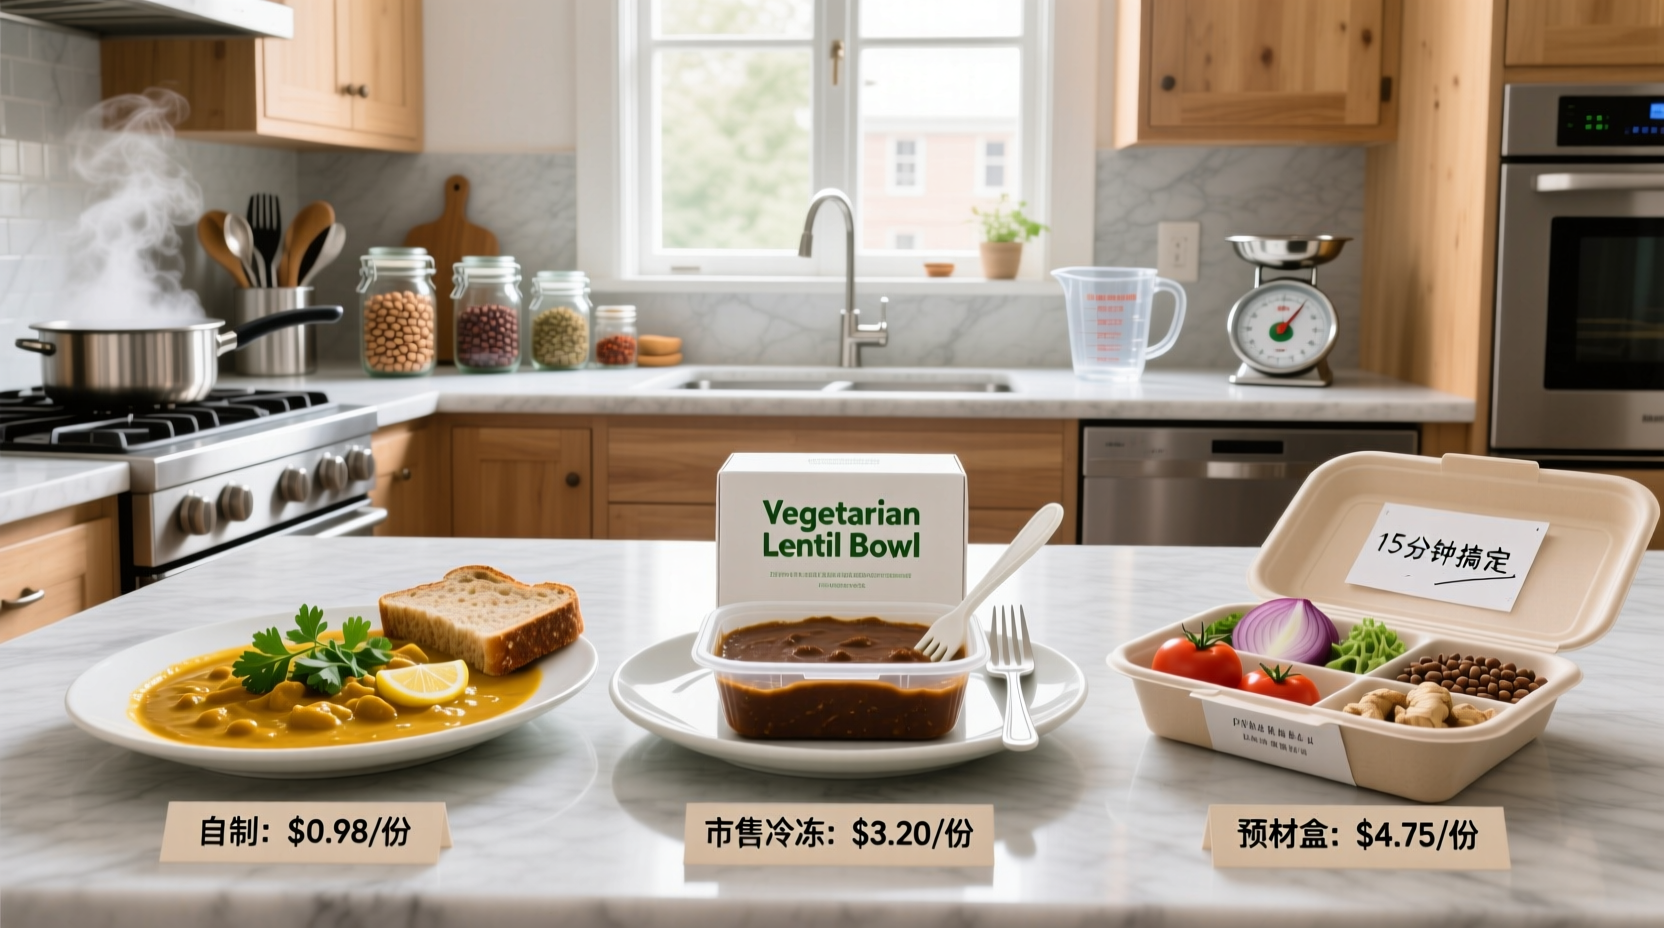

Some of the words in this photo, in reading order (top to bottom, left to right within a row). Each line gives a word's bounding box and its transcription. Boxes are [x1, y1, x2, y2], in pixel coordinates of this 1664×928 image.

[762, 499, 921, 532] Vegetarian
[763, 532, 841, 558] Lentil
[849, 532, 921, 558] Bowl
[1377, 532, 1511, 575] 15分钟搞定
[287, 815, 412, 848] $0.98/份
[852, 816, 974, 850] $3.20/份
[1356, 817, 1479, 852] $4.75/份
